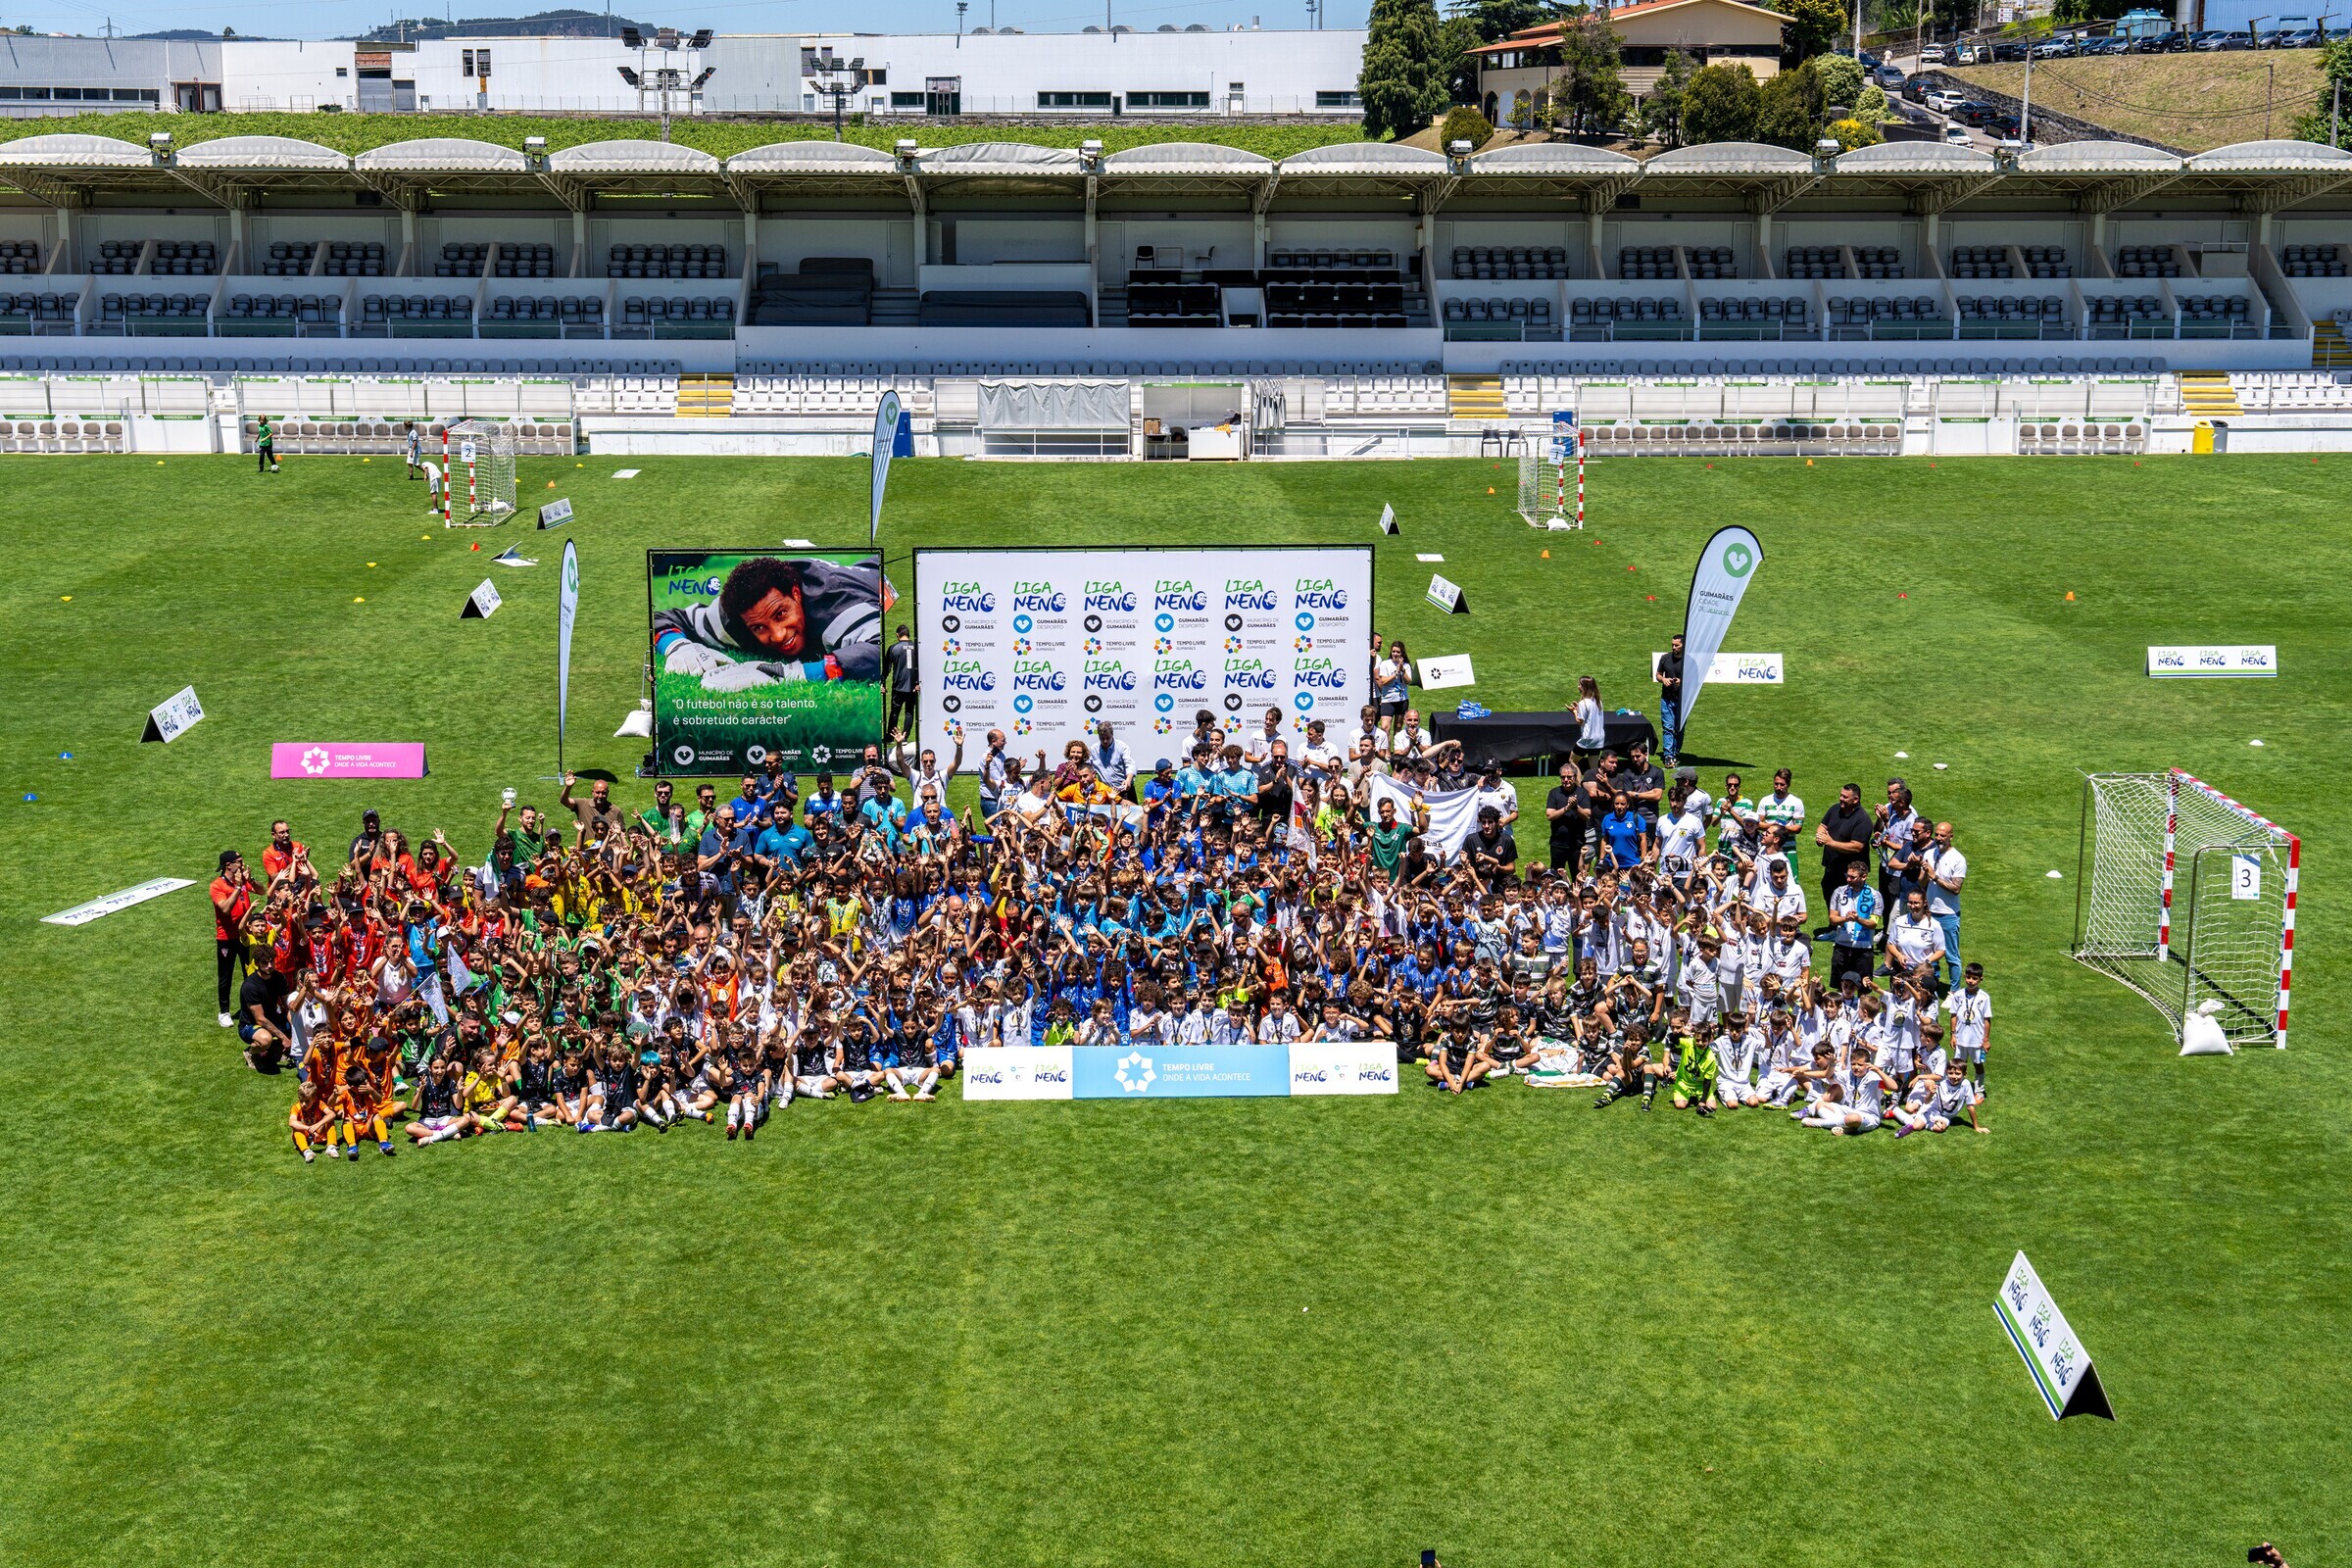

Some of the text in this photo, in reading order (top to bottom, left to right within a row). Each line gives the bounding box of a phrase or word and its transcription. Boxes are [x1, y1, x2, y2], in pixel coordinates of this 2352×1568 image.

[466, 448, 471, 457] 2
[669, 565, 705, 577] LIGA
[668, 576, 721, 595] NENO
[943, 582, 981, 594] LIGA
[1014, 581, 1052, 594] LIGA
[1085, 581, 1122, 594] LIGA
[1155, 580, 1192, 593] LIGA
[1225, 579, 1263, 592] LIGA
[1295, 579, 1333, 591] LIGA
[943, 593, 995, 612] NENO
[1014, 593, 1066, 612] NENO
[1085, 592, 1136, 612] NENO
[1155, 591, 1206, 611] NENO
[1225, 591, 1277, 610] NENO
[1295, 590, 1347, 609] NENO
[1700, 591, 1733, 601] GUIMARÃES
[943, 660, 981, 673] LIGA
[1014, 660, 1052, 673] LIGA
[1084, 660, 1122, 673] LIGA
[1154, 659, 1192, 672] LIGA
[1224, 658, 1262, 671] LIGA
[1294, 657, 1332, 670] LIGA
[1738, 658, 1766, 667] LIGA
[2158, 656, 2184, 666] NENO
[2200, 655, 2226, 665] NENO
[2241, 655, 2267, 665] NENO
[1224, 669, 1276, 689] NENO
[1294, 668, 1346, 688] NENO
[1738, 666, 1777, 679] NENO
[943, 672, 995, 691] NENO
[1014, 671, 1066, 691] NENO
[1084, 671, 1136, 691] NENO
[1154, 670, 1206, 690] NENO
[687, 698, 725, 709] futebol
[729, 699, 748, 709] não
[751, 699, 758, 709] é
[760, 699, 773, 708] só
[776, 698, 818, 709] talento,
[673, 715, 679, 725] é
[683, 715, 739, 725] sobretudo
[2241, 869, 2251, 887] 3
[971, 1072, 1003, 1083] NENO
[1035, 1070, 1068, 1082] NENO
[1213, 1073, 1250, 1081] ACONTECE
[1295, 1070, 1327, 1082] NENO
[1359, 1069, 1391, 1081] NENO
